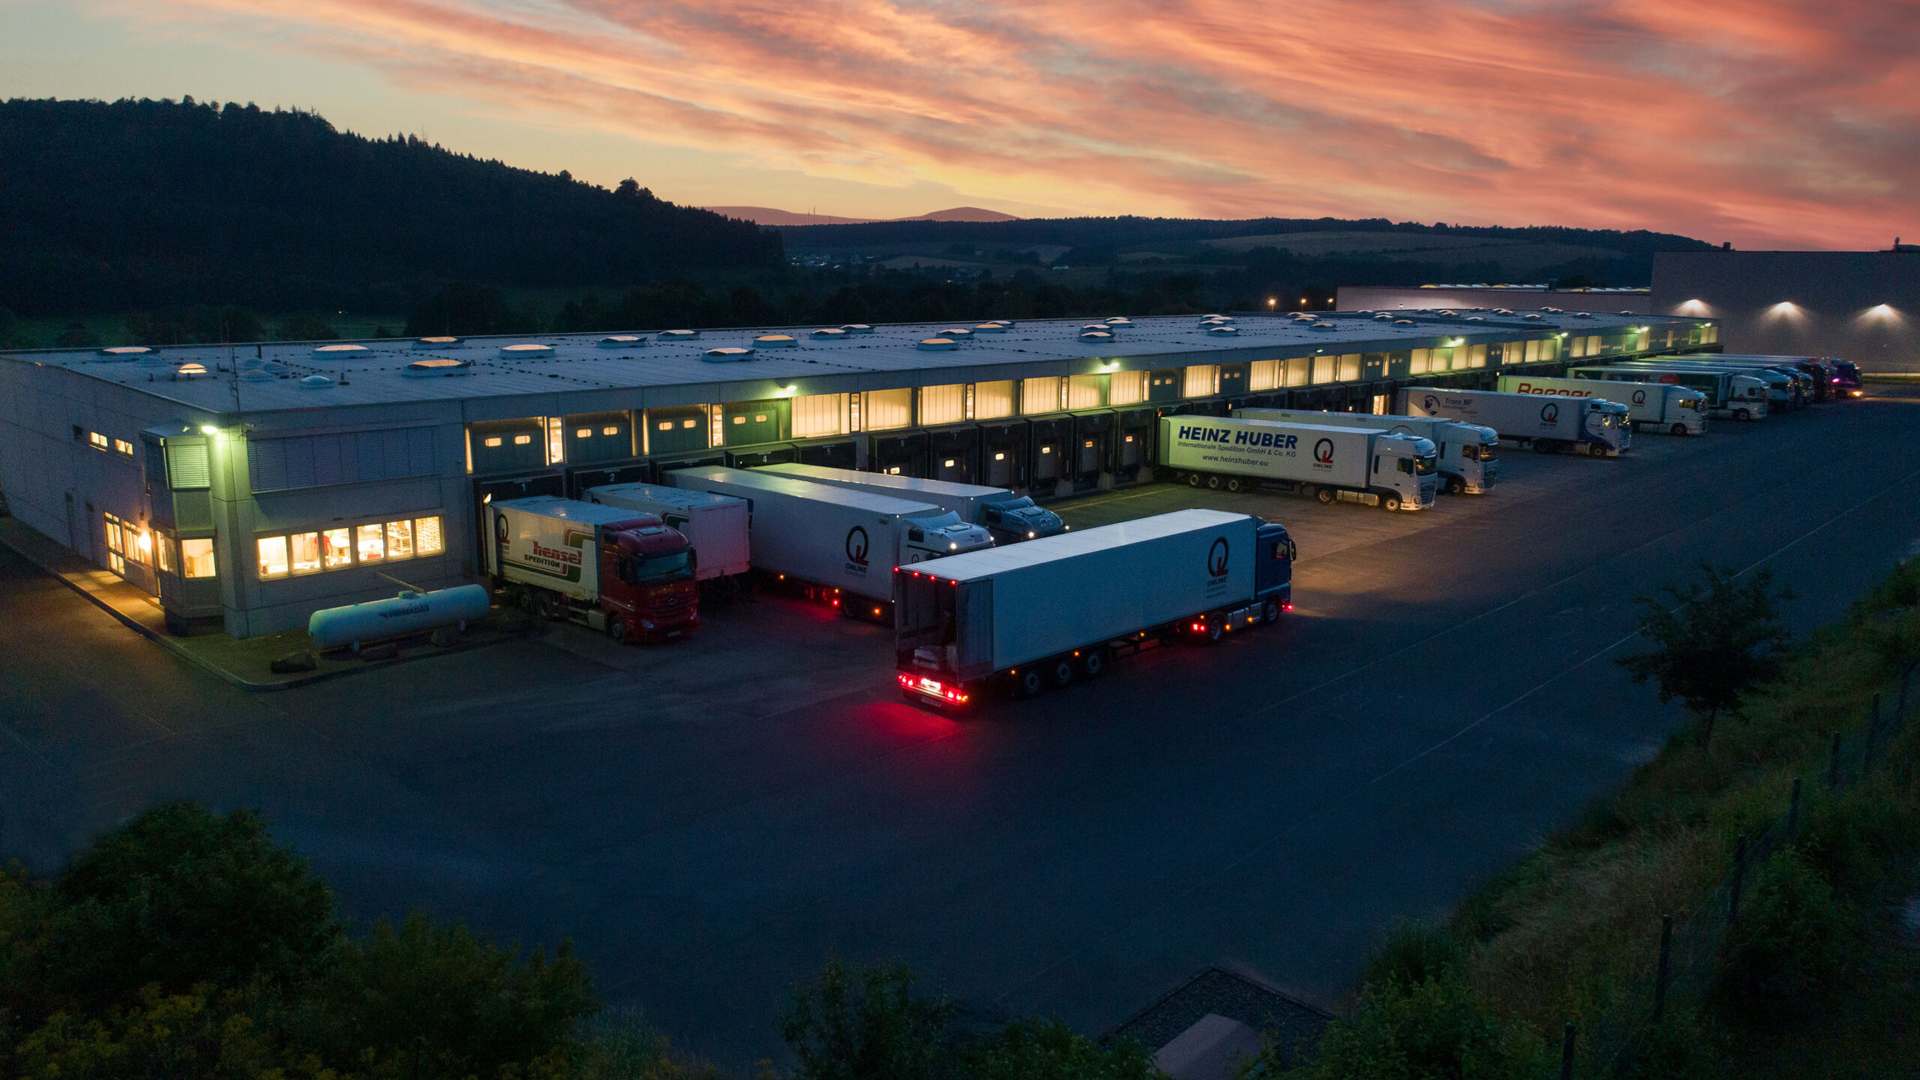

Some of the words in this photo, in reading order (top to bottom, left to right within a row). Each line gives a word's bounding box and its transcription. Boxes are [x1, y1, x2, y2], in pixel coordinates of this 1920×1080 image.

[953, 433, 958, 442] 7
[1179, 426, 1231, 444] HEINZ
[1235, 431, 1298, 449] HUBER
[826, 447, 831, 456] 5
[1178, 440, 1217, 450] Internationale
[1218, 444, 1245, 454] Spedition
[1247, 447, 1266, 455] GmbH
[762, 455, 768, 463] 4
[1202, 454, 1269, 467] www.heinzhuber.eu
[609, 473, 616, 482] 2
[521, 482, 526, 493] 1
[533, 541, 583, 565] hensel
[524, 554, 561, 568] SPEDITION
[846, 563, 867, 574] ONLINE
[1207, 577, 1227, 588] ONLINE
